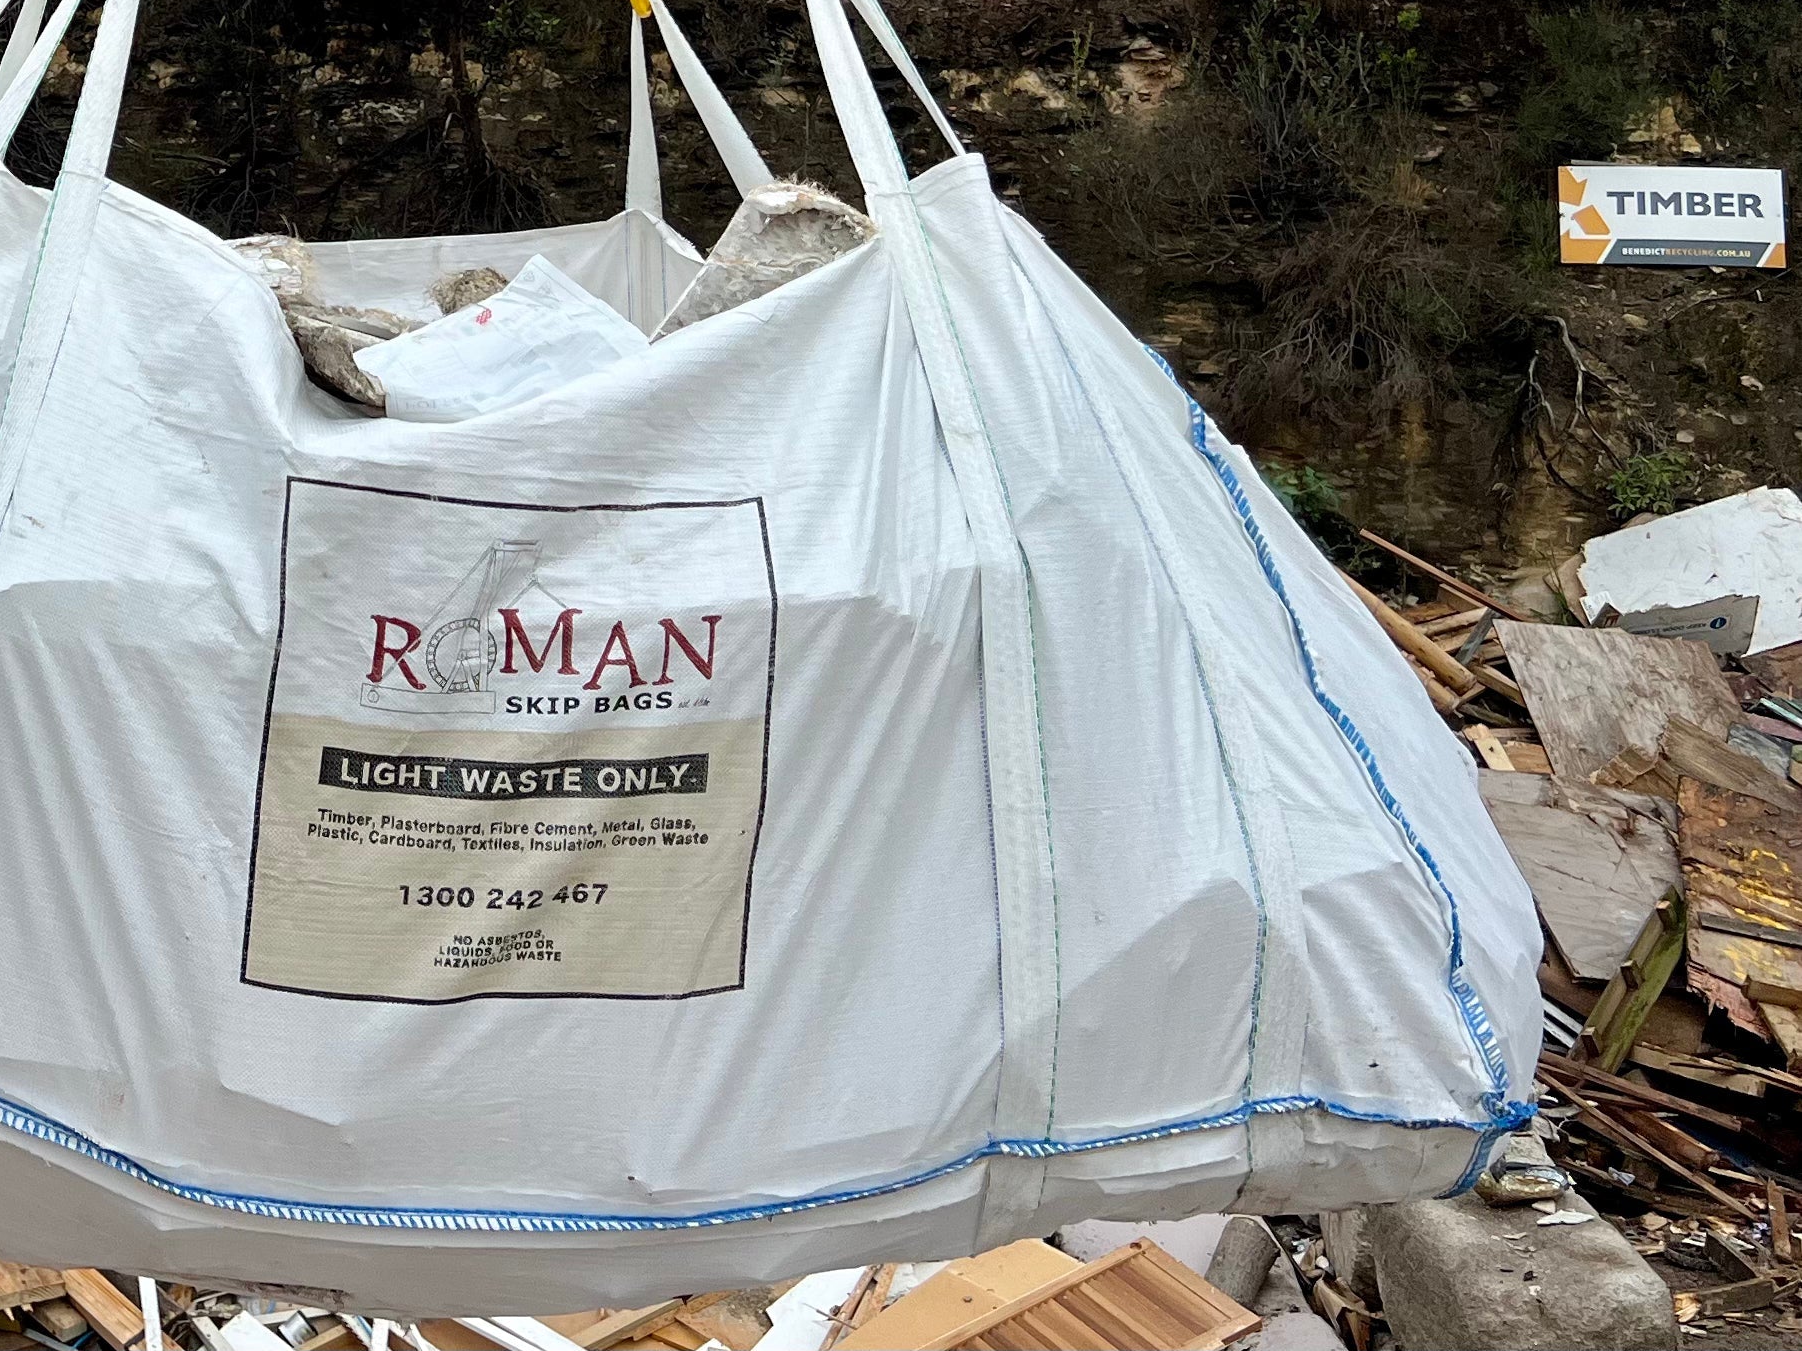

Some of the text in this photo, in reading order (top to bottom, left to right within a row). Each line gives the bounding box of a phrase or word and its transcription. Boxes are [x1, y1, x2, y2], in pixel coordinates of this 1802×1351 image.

[1606, 191, 1765, 218] TIMBER
[365, 608, 722, 690] ROMAN
[506, 696, 580, 715] SKIP
[594, 691, 673, 714] BAGS
[341, 757, 690, 795] LIGHT WASTE ONLY
[318, 808, 696, 837] Timber, Plasterboard, Fibre Cement, Metal, Glass,
[307, 823, 709, 853] Plastic, Cardboard, Textiles, Insulation, Green Waste
[399, 883, 608, 910] 1300 242 467
[453, 929, 545, 946] NO ASBESTOS,
[499, 940, 531, 954] FOOD
[535, 940, 554, 950] OR
[434, 951, 562, 968] HAZARDOUS WASTE
